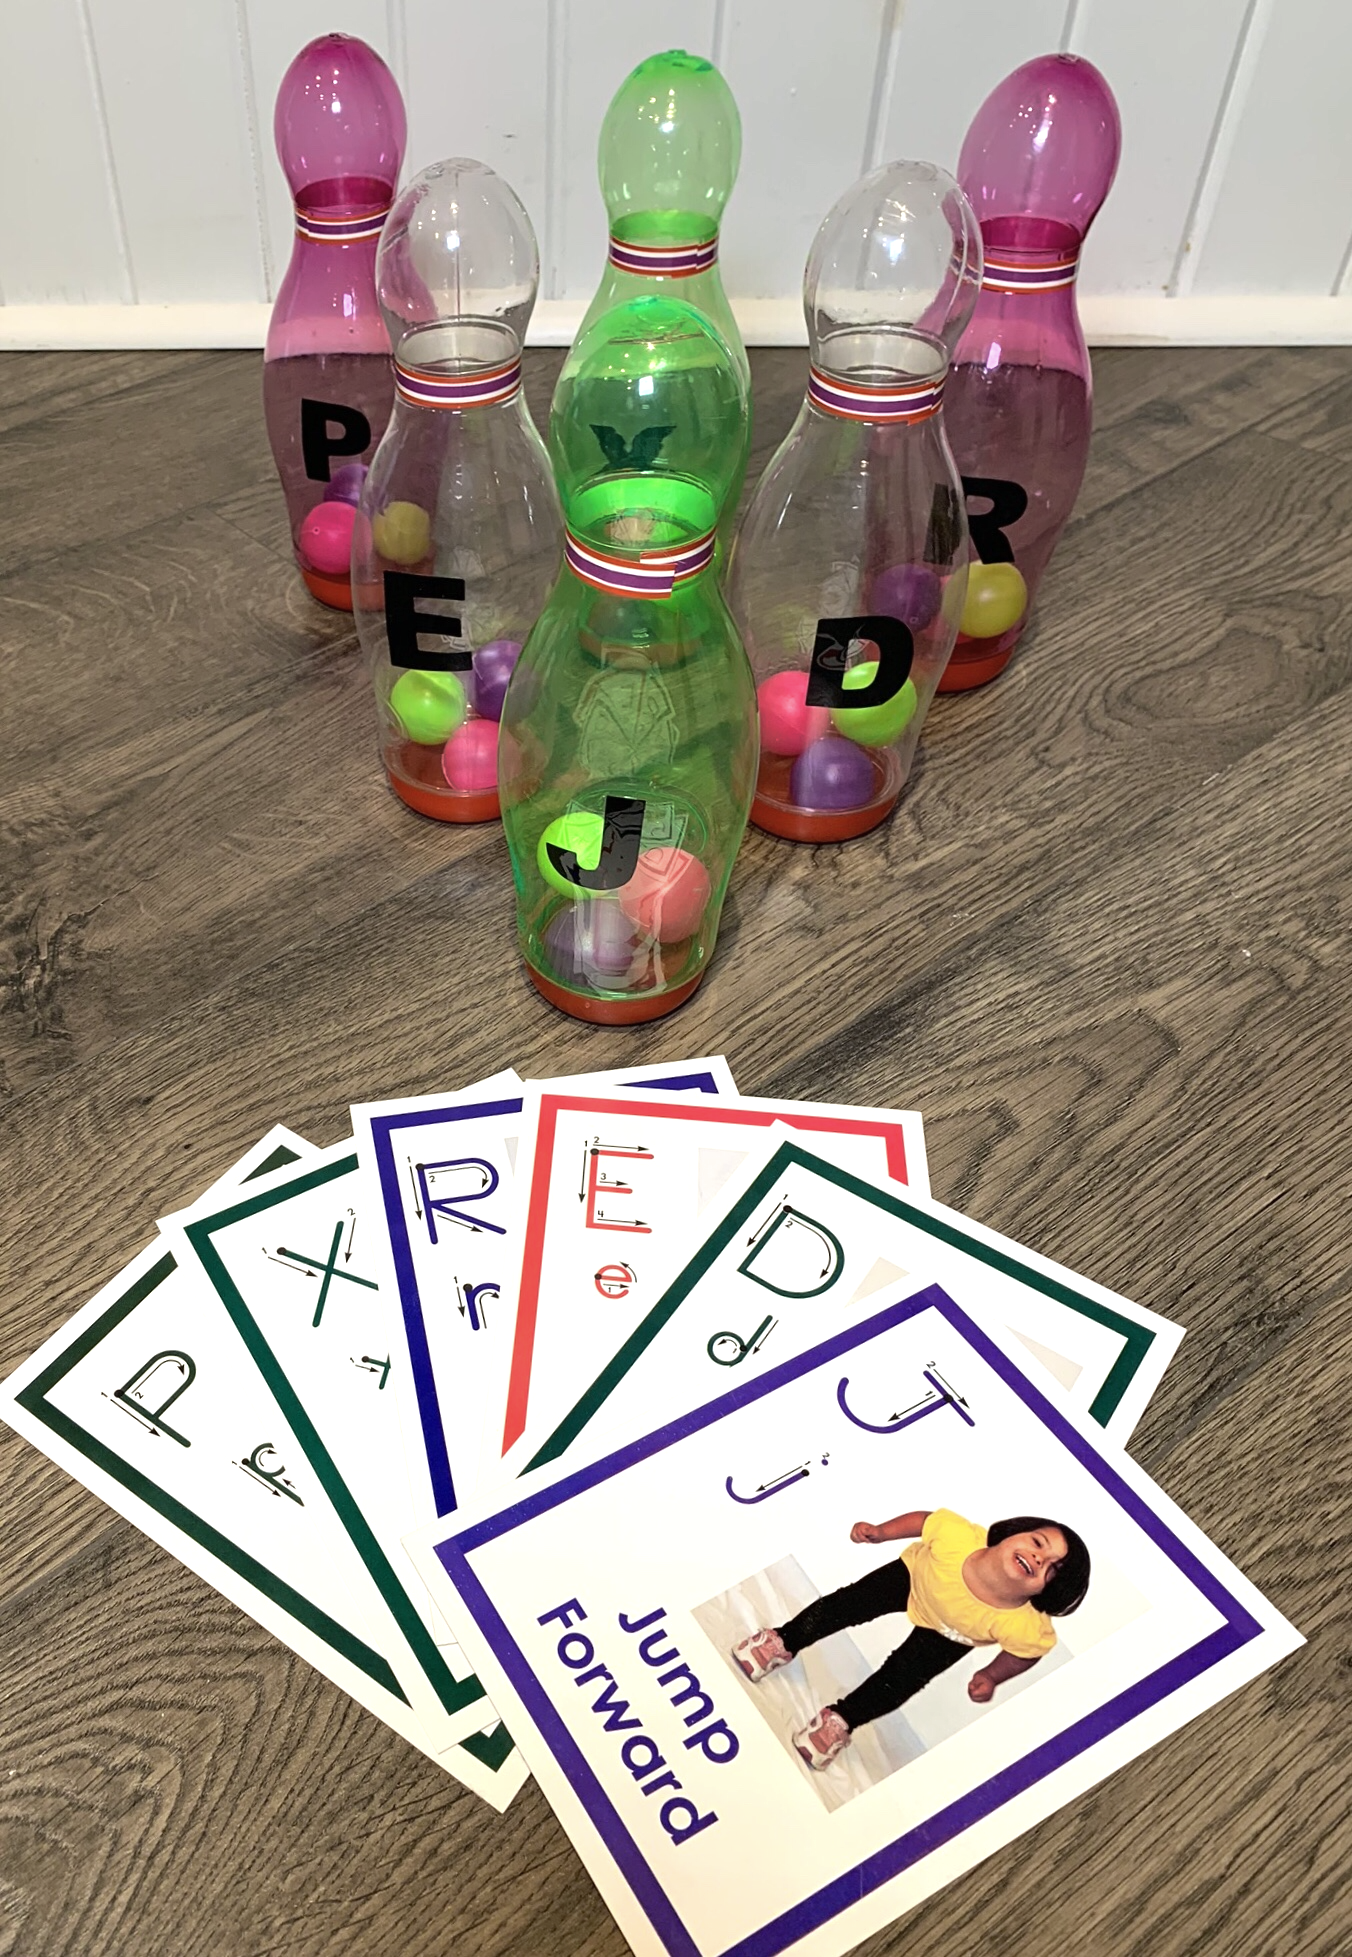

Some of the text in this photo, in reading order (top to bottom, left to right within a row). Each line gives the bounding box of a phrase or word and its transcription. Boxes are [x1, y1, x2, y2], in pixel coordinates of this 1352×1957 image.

[301, 398, 371, 482] P
[922, 475, 1028, 565] R
[383, 570, 473, 672] E
[805, 615, 914, 709] D
[546, 795, 646, 891] J
[415, 1158, 507, 1245] R
[586, 1148, 654, 1234] E
[597, 1210, 604, 1218] 4
[276, 1221, 379, 1328] X
[594, 1265, 632, 1299] e
[737, 1204, 845, 1299] D
[462, 1283, 500, 1331] r
[707, 1315, 773, 1367] d
[114, 1350, 196, 1448] P
[837, 1370, 975, 1434] J
[725, 1458, 829, 1504] j
[536, 1597, 719, 1846] Forward
[618, 1607, 739, 1764] Jump
